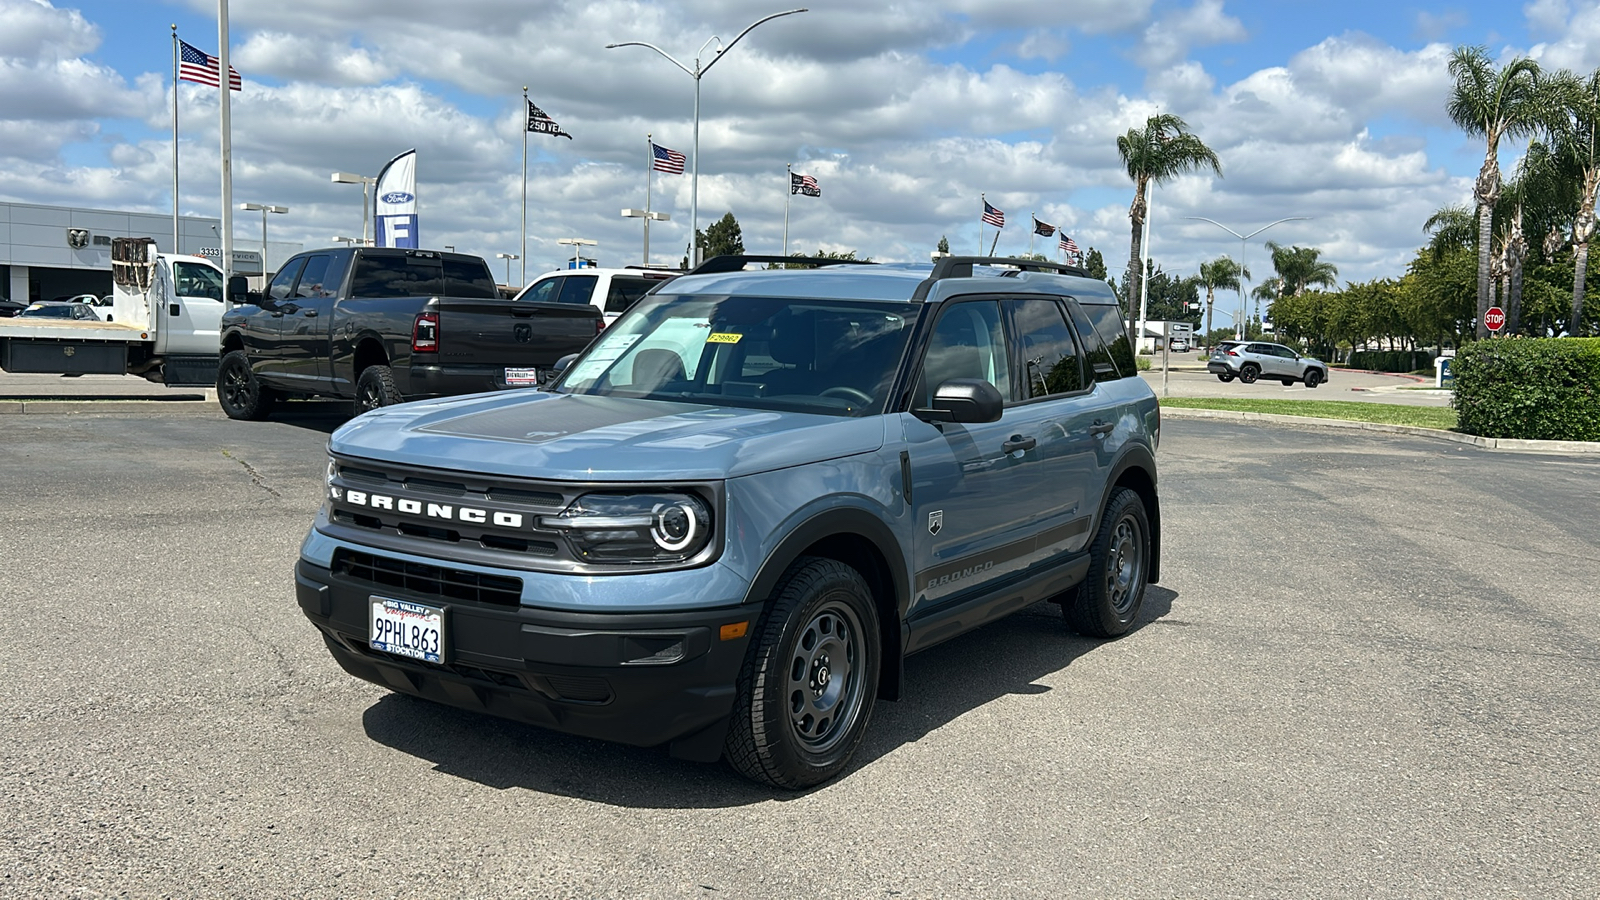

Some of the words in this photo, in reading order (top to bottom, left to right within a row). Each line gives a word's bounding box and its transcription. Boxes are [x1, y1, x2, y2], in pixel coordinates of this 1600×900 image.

[529, 120, 546, 131] 250
[548, 123, 566, 133] YEA
[386, 193, 408, 203] Ford
[201, 247, 220, 256] 3333
[1486, 314, 1503, 323] STOP
[347, 489, 523, 528] BRONCO
[926, 560, 994, 590] BRONCO
[400, 603, 424, 614] VALLEY
[375, 617, 439, 653] 9PHL863
[386, 643, 425, 659] STOCKTON
